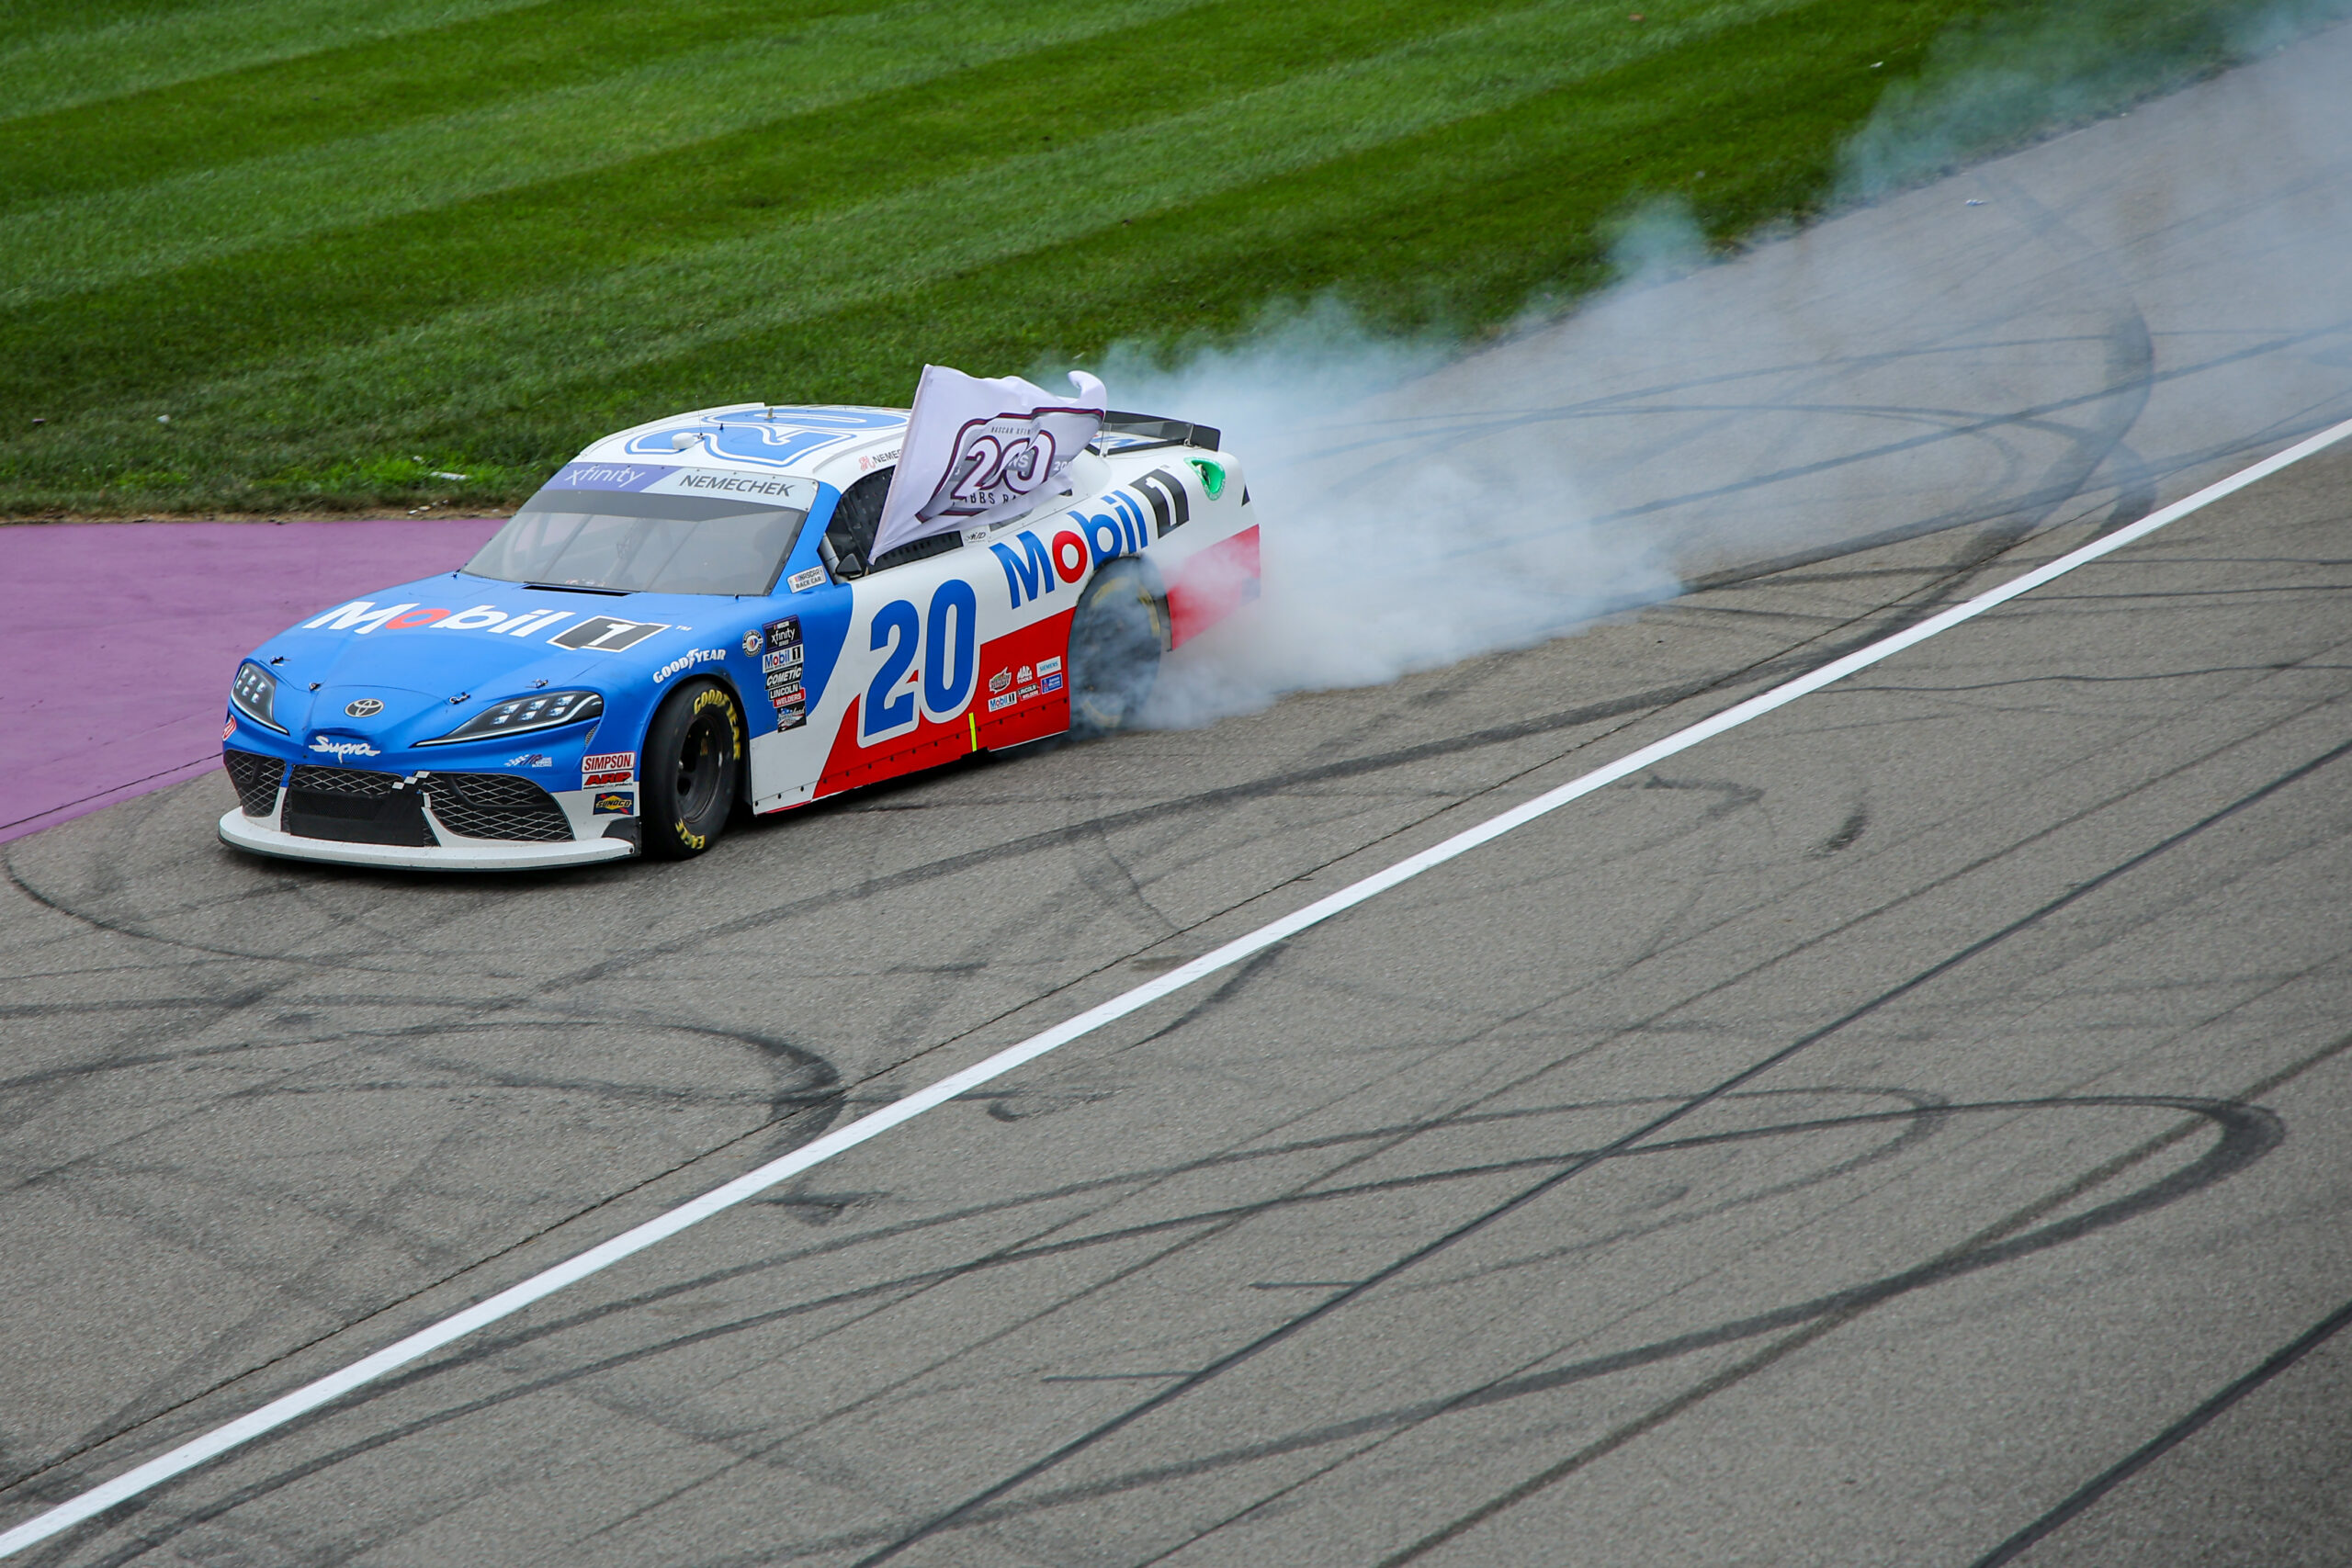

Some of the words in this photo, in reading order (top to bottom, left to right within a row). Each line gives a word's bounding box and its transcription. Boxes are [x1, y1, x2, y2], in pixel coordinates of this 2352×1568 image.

[624, 407, 910, 468] 20
[950, 430, 1056, 501] 20
[564, 465, 646, 489] xfinity
[679, 474, 796, 497] NEMECHEK
[989, 490, 1149, 610] Mobil
[795, 580, 810, 589] RACE
[810, 575, 822, 585] CAR
[301, 601, 577, 637] Mobil
[771, 627, 796, 646] xfinity
[652, 648, 727, 684] GOODYEAR
[764, 649, 790, 669] Mobil
[868, 578, 978, 739] 20
[1039, 661, 1058, 672] SIEMENS
[766, 666, 802, 686] COMETIC
[770, 683, 798, 698] LINCOLN
[775, 693, 802, 706] WELDERS
[1018, 684, 1037, 695] LINCOLN
[989, 695, 1008, 708] Mobil
[694, 689, 741, 760] GOODYEAR
[309, 735, 381, 764] Supra
[583, 753, 632, 772] SIMPSON
[583, 771, 632, 786] ARP
[596, 798, 631, 808] SUNOCO
[674, 818, 706, 849] EAGLE
